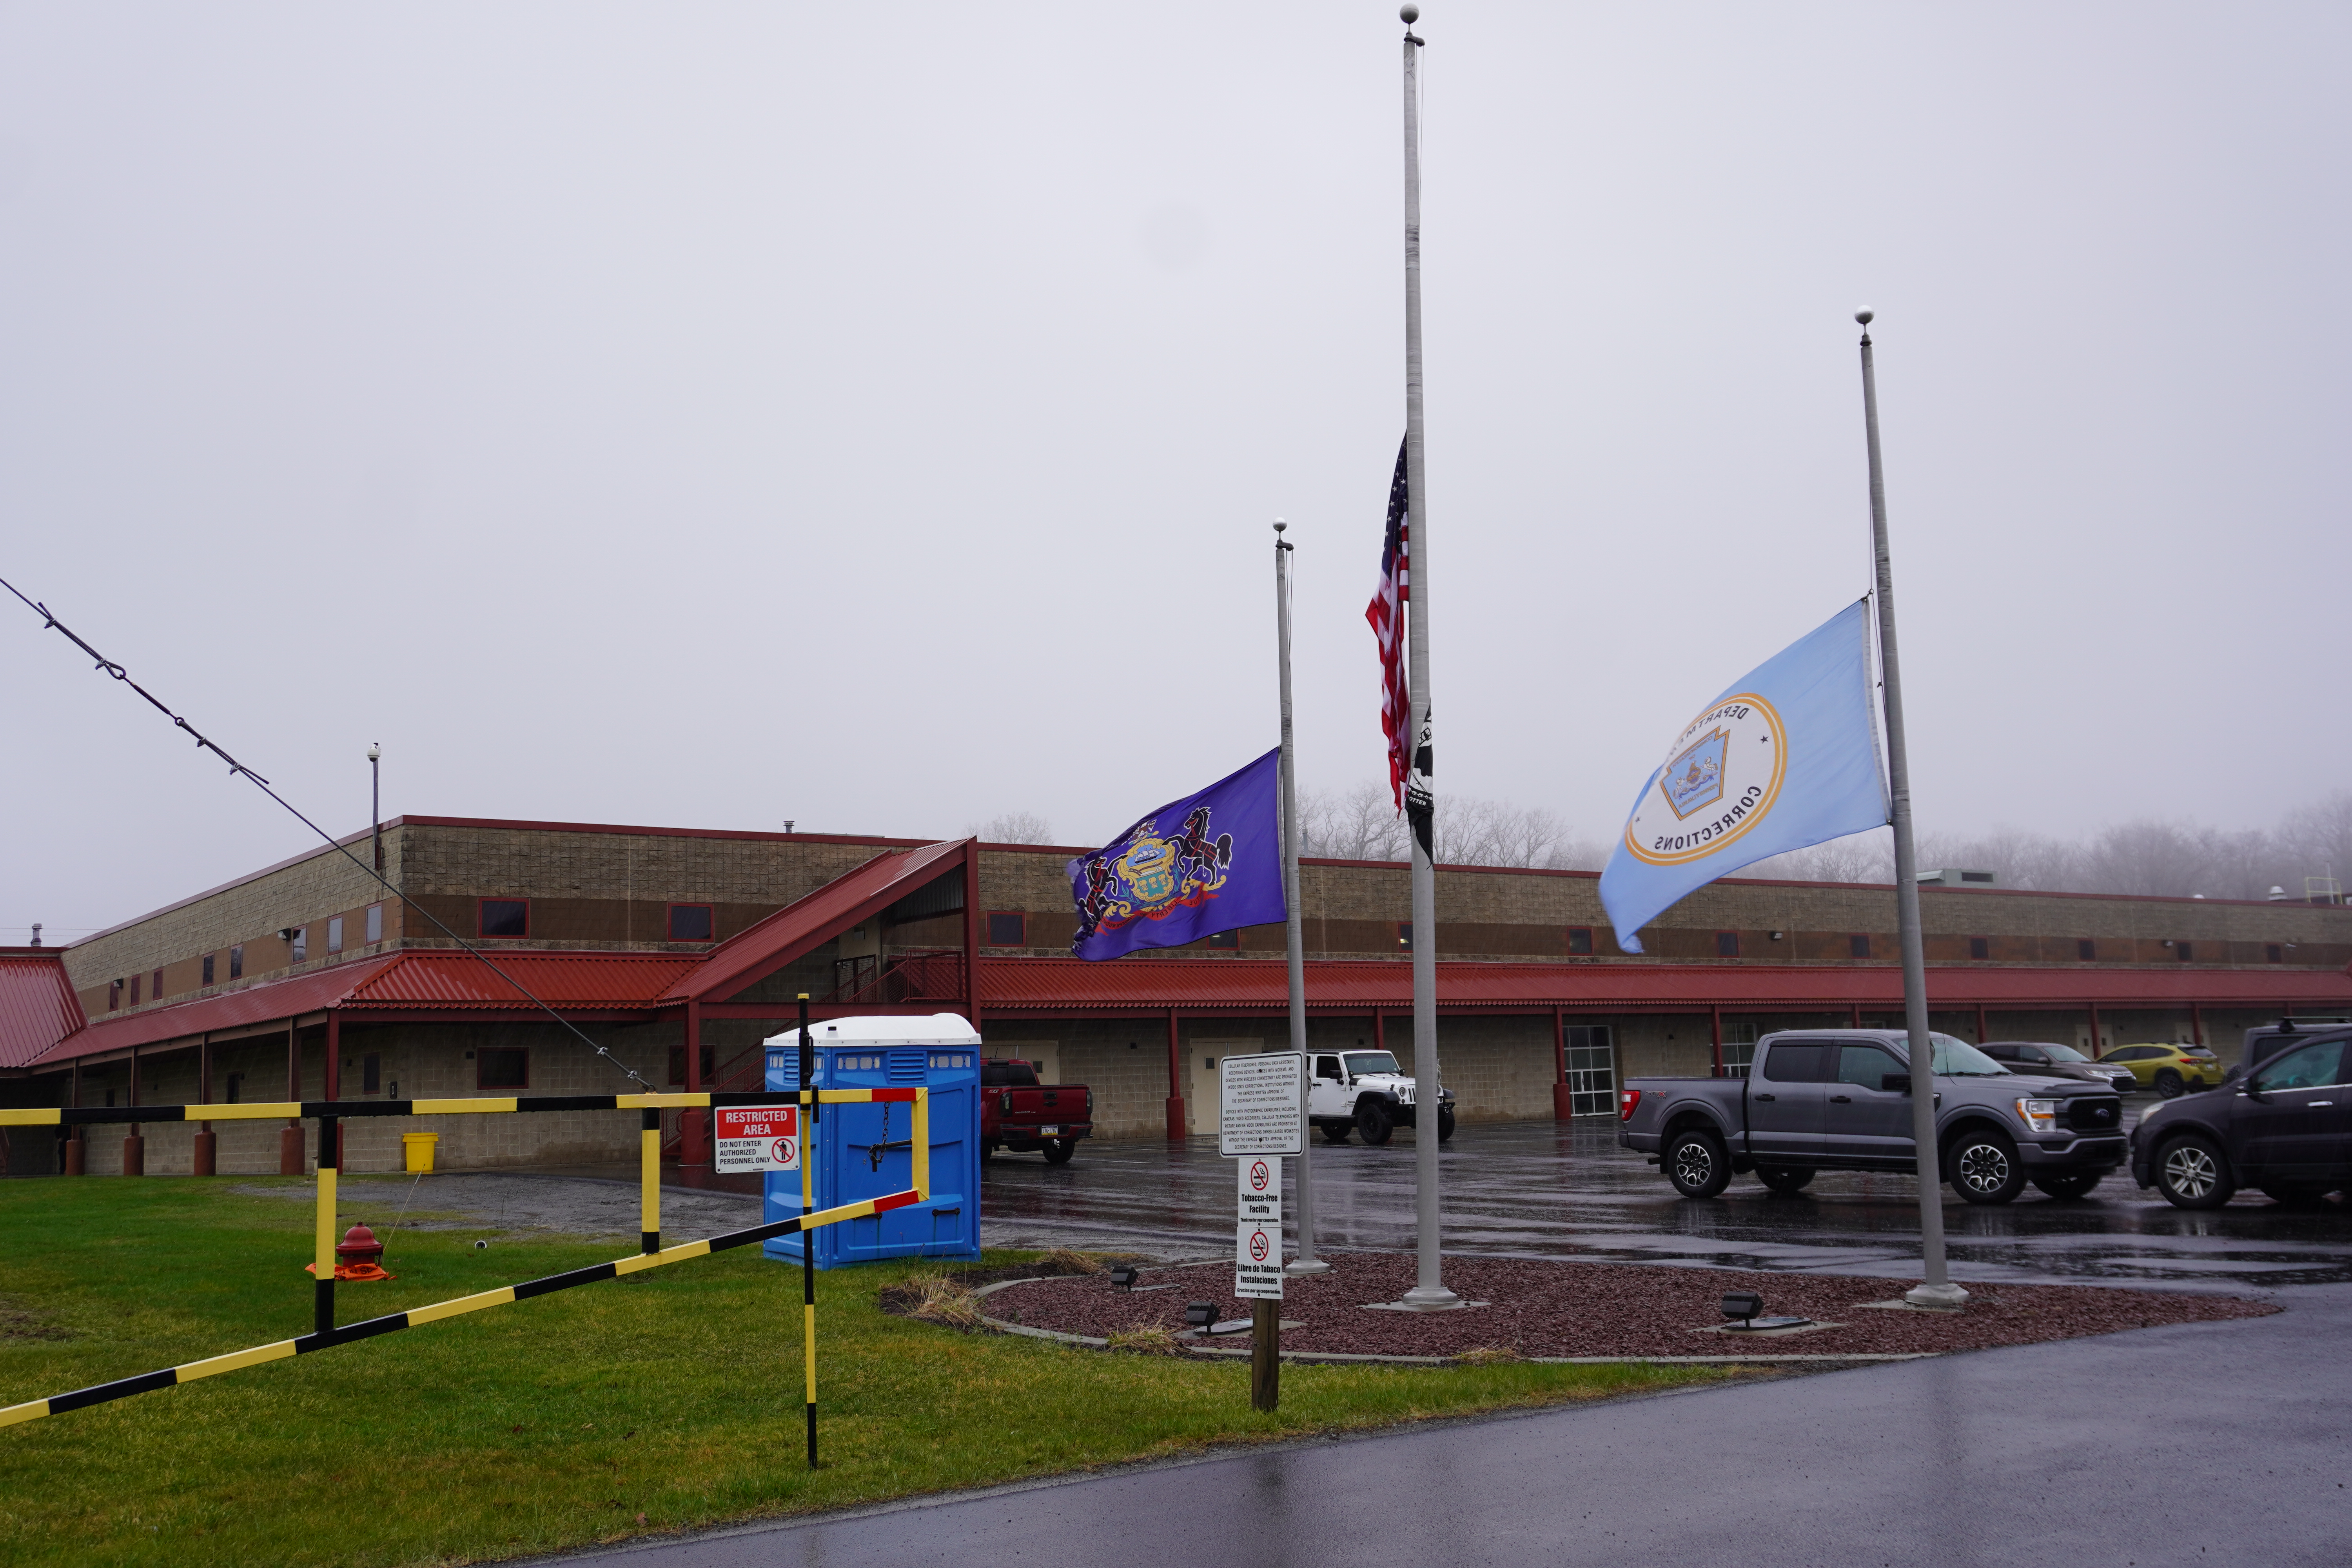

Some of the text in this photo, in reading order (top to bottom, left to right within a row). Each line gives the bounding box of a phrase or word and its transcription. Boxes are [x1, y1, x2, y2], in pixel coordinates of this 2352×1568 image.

[1408, 795, 1426, 806] OTTEN
[392, 1085, 394, 1095] D
[726, 1111, 787, 1123] RESTRICTED
[743, 1124, 771, 1135] AREA
[1249, 1205, 1269, 1214] Facility
[1238, 1264, 1252, 1272] Libre
[1261, 1265, 1280, 1273] Tabaco
[1241, 1276, 1277, 1285] Instalaciones
